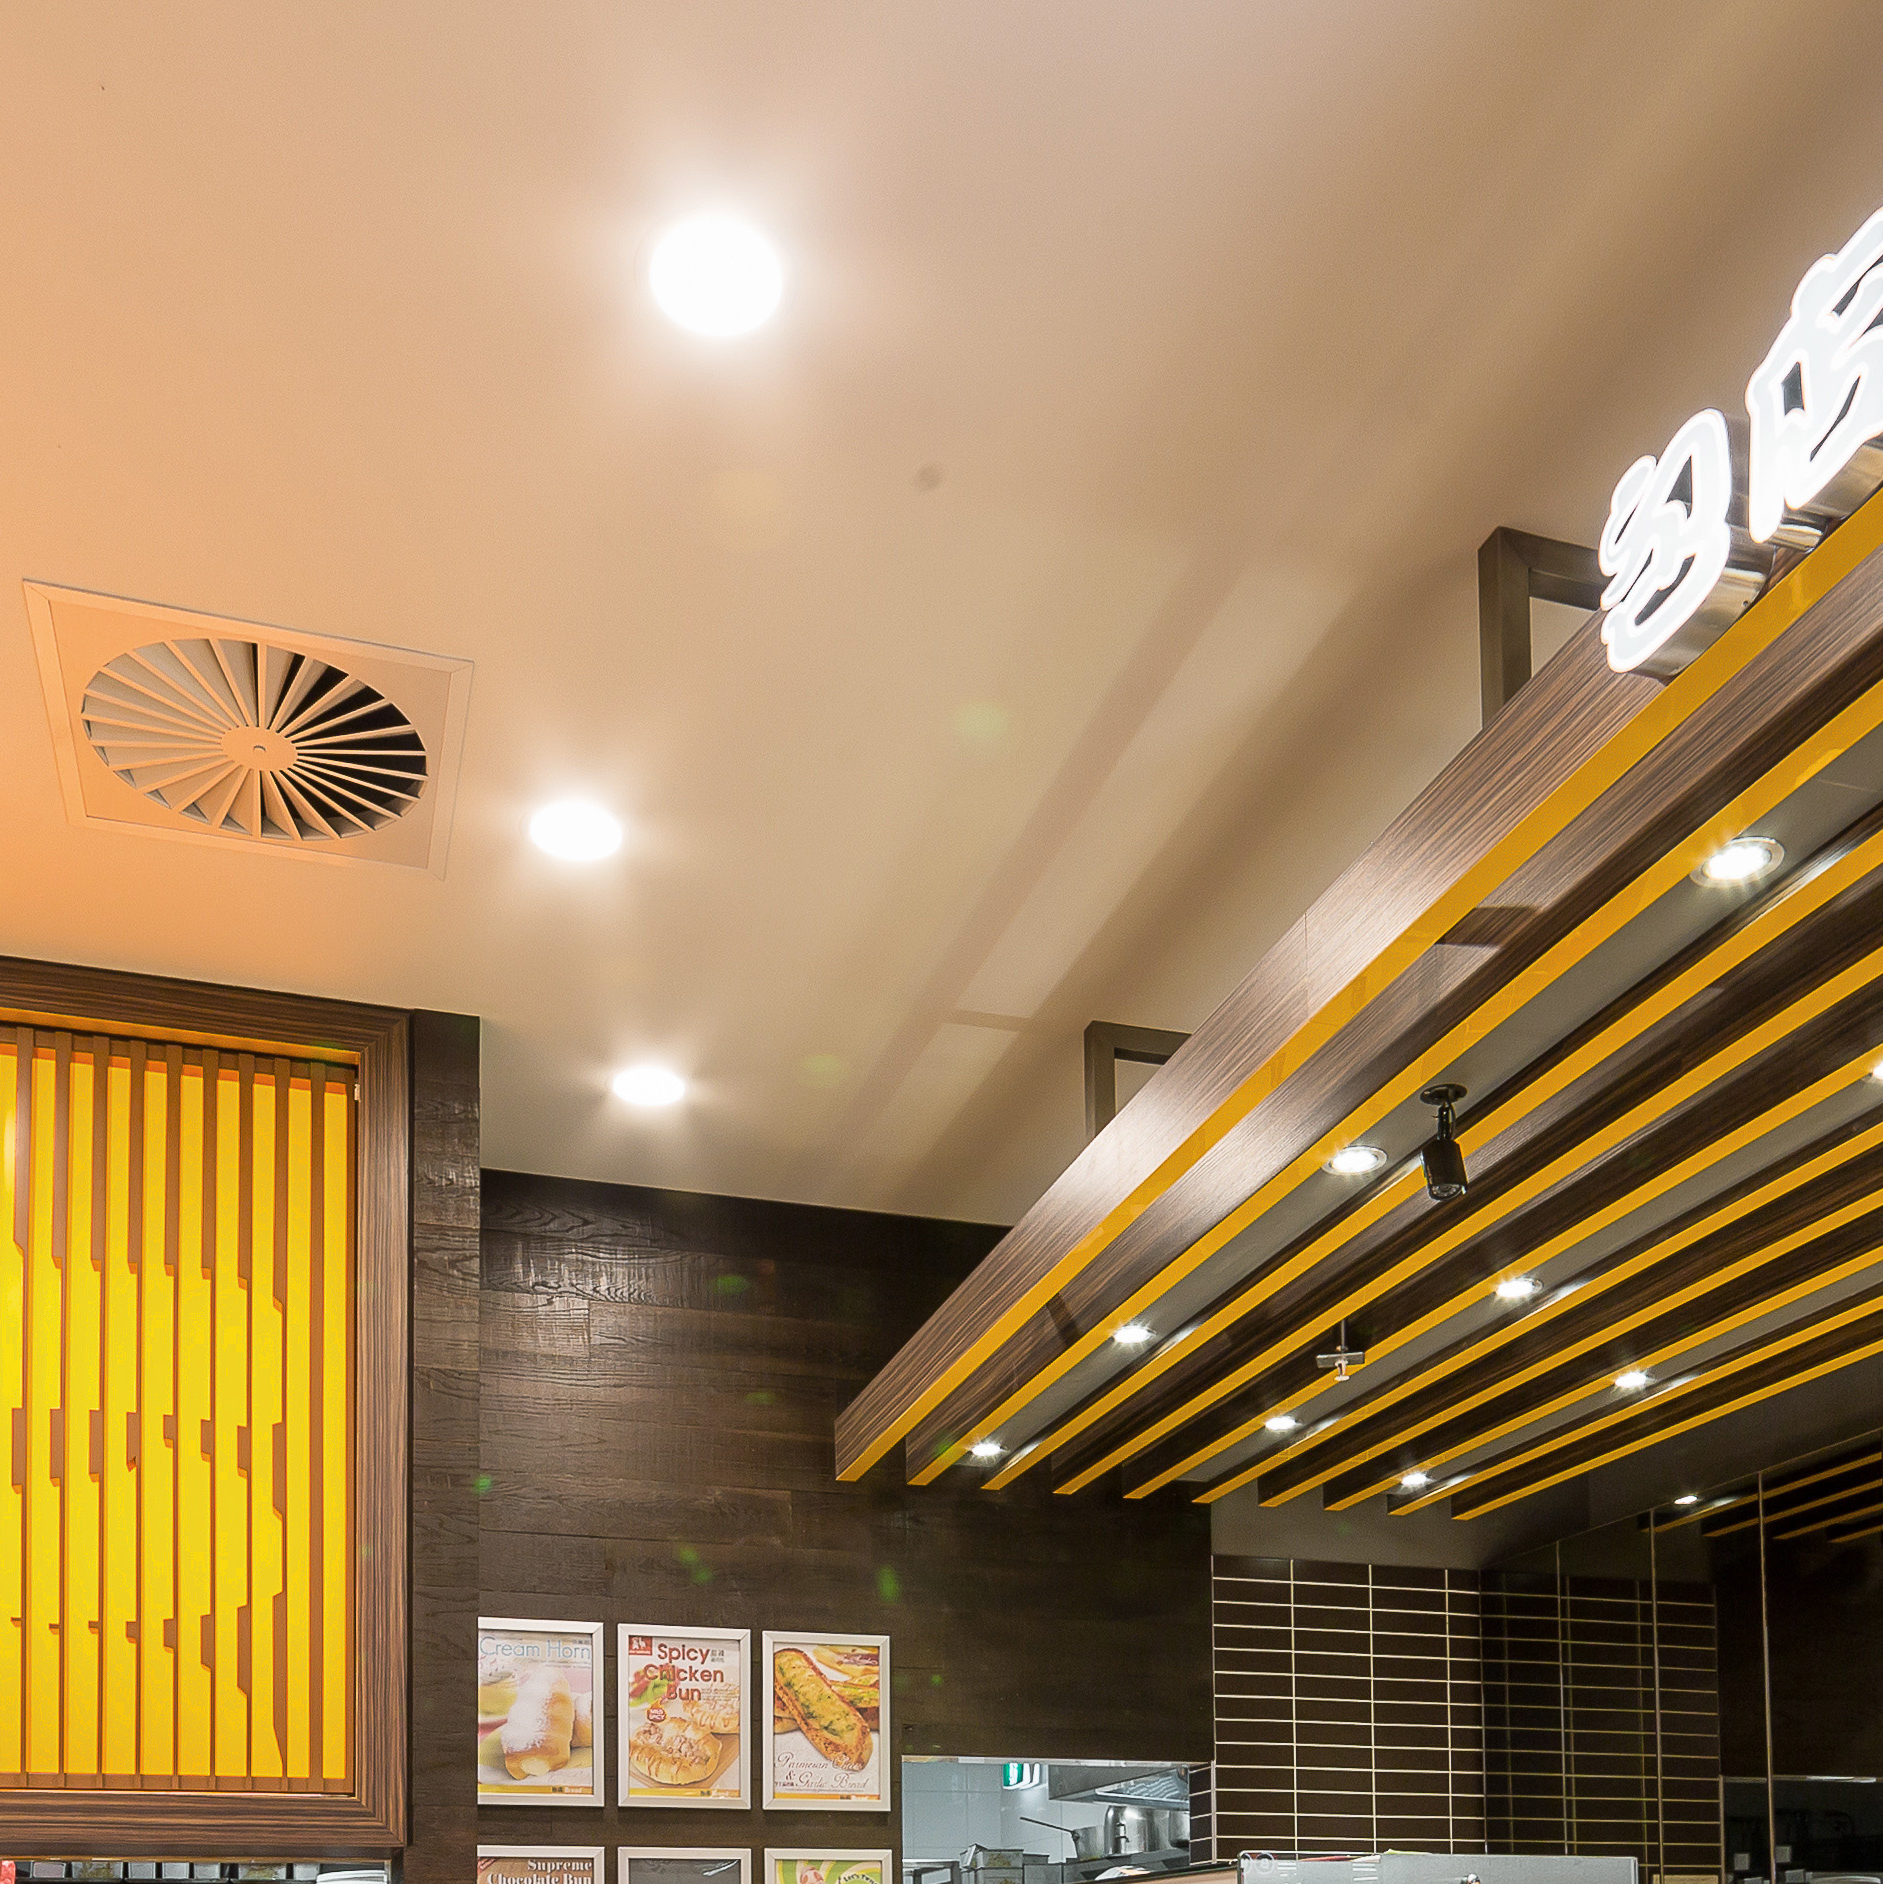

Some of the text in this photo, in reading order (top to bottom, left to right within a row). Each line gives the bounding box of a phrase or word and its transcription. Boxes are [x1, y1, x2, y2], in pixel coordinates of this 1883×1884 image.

[479, 1635, 591, 1660] Cream Horn
[657, 1642, 711, 1665] Spicy
[642, 1663, 725, 1683] Chicken
[666, 1683, 702, 1701] Bun
[785, 1770, 796, 1780] &
[830, 1771, 870, 1789] Bread
[527, 1859, 593, 1873] Supreme
